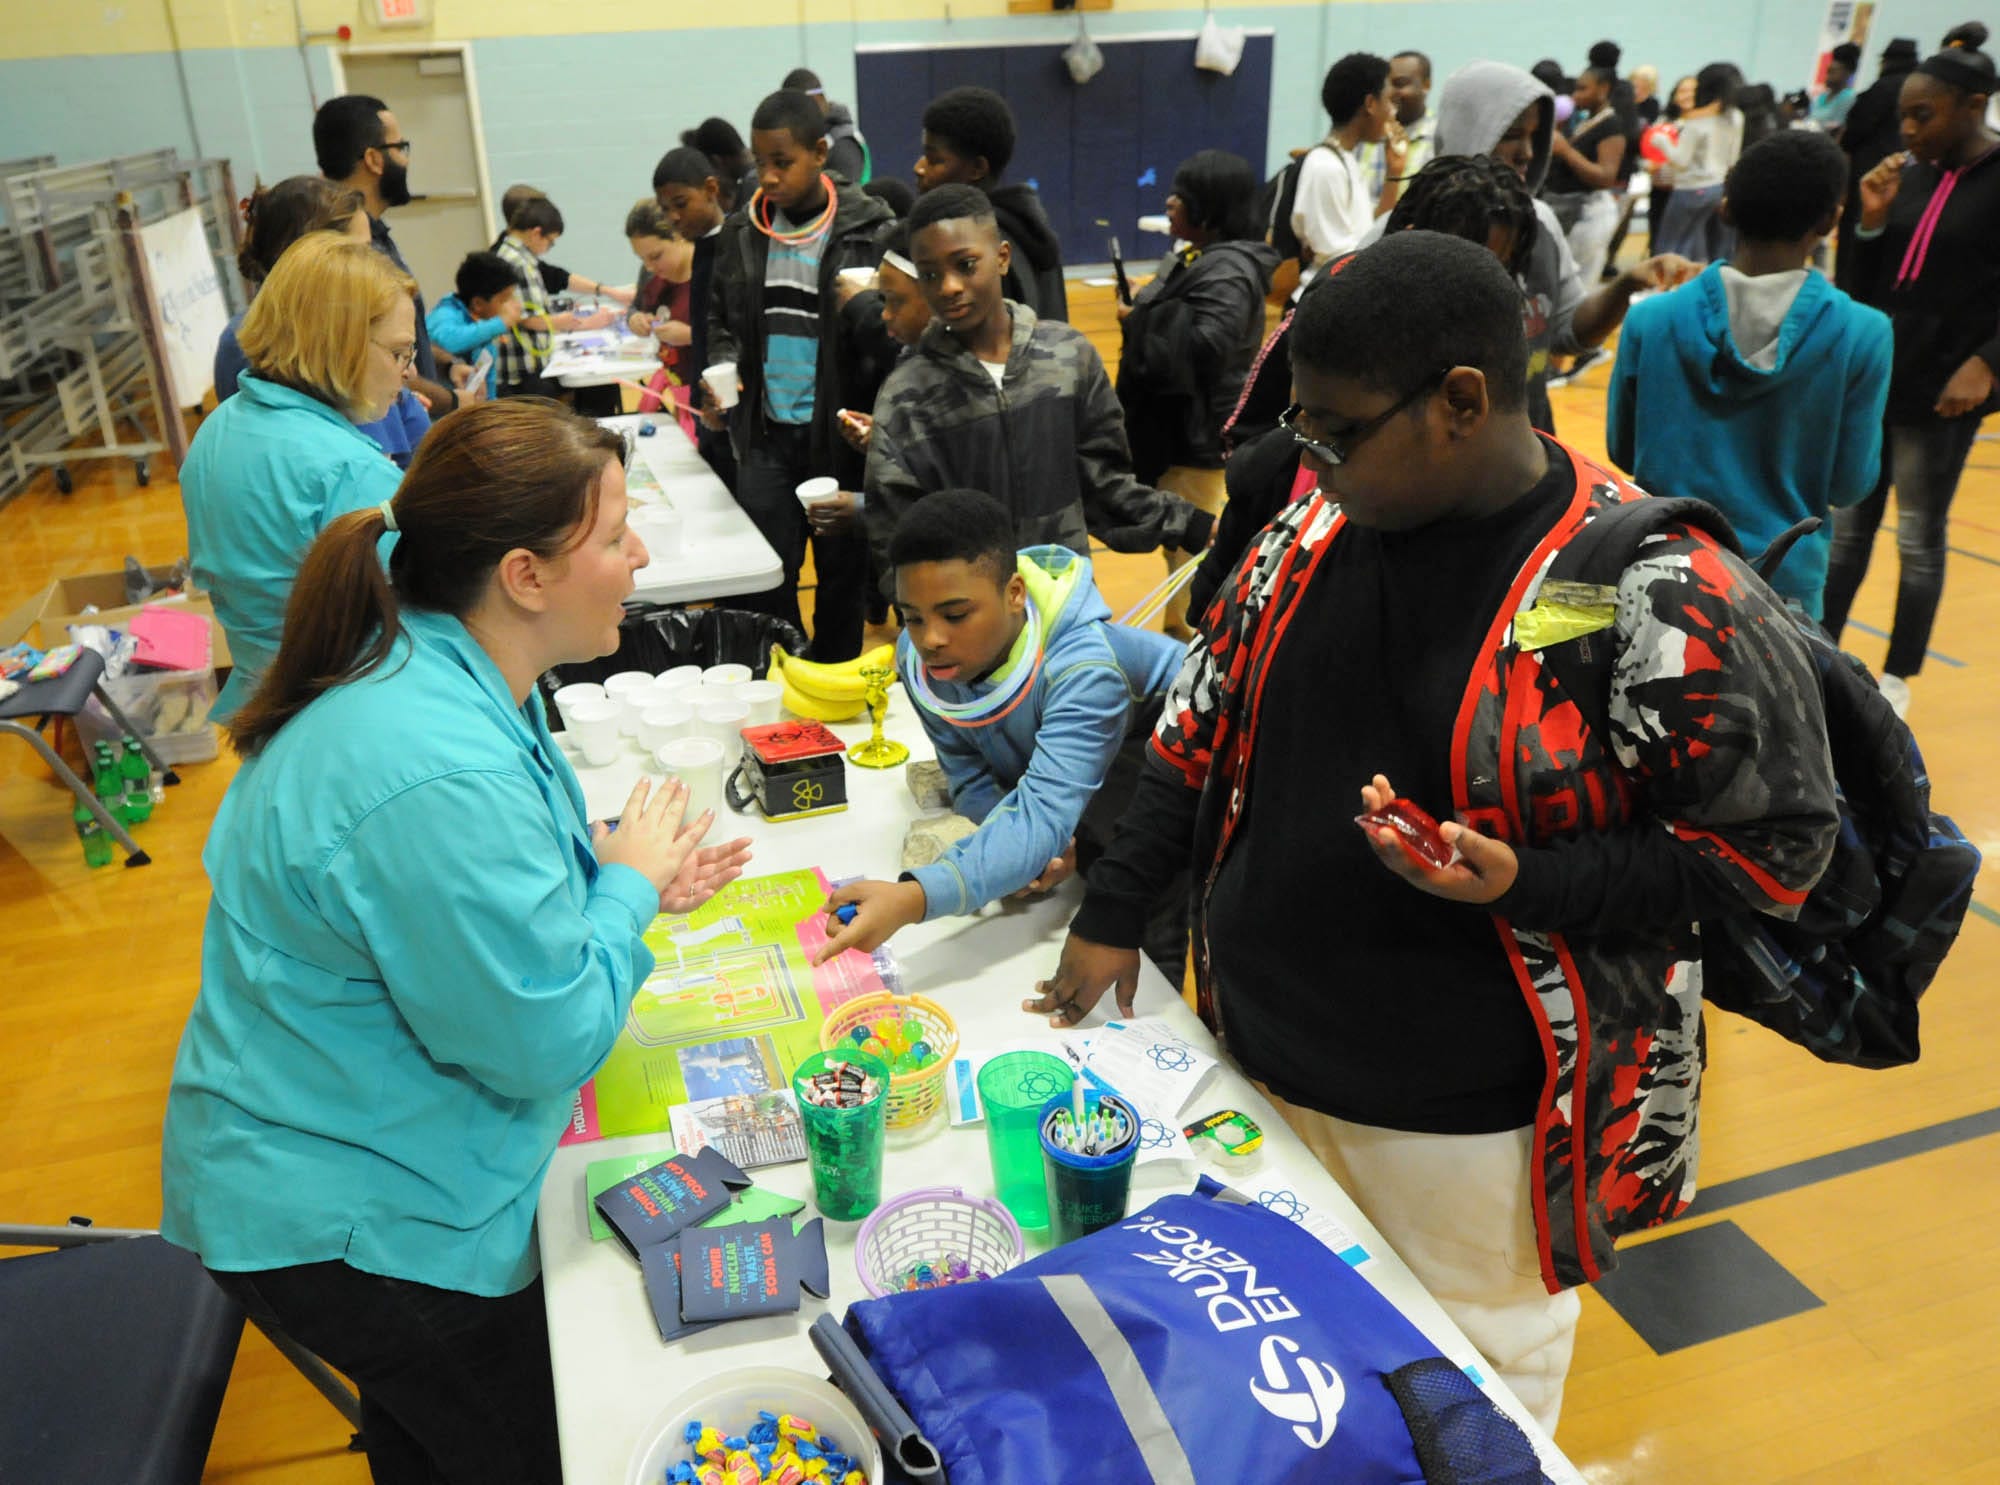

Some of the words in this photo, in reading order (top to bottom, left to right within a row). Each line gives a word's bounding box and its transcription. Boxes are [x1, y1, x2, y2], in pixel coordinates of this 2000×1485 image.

[573, 1106, 587, 1135] HOW
[629, 1185, 662, 1217] POWER
[639, 1176, 677, 1213] NUCLEAR
[656, 1172, 686, 1201] WASTE
[681, 1173, 709, 1199] SODA
[759, 1232, 775, 1256] CAN
[709, 1247, 725, 1288] POWER
[725, 1242, 741, 1295] NUCLEAR
[743, 1245, 759, 1284] WASTE
[764, 1256, 779, 1296] SODA
[1131, 1250, 1257, 1332] DUKE
